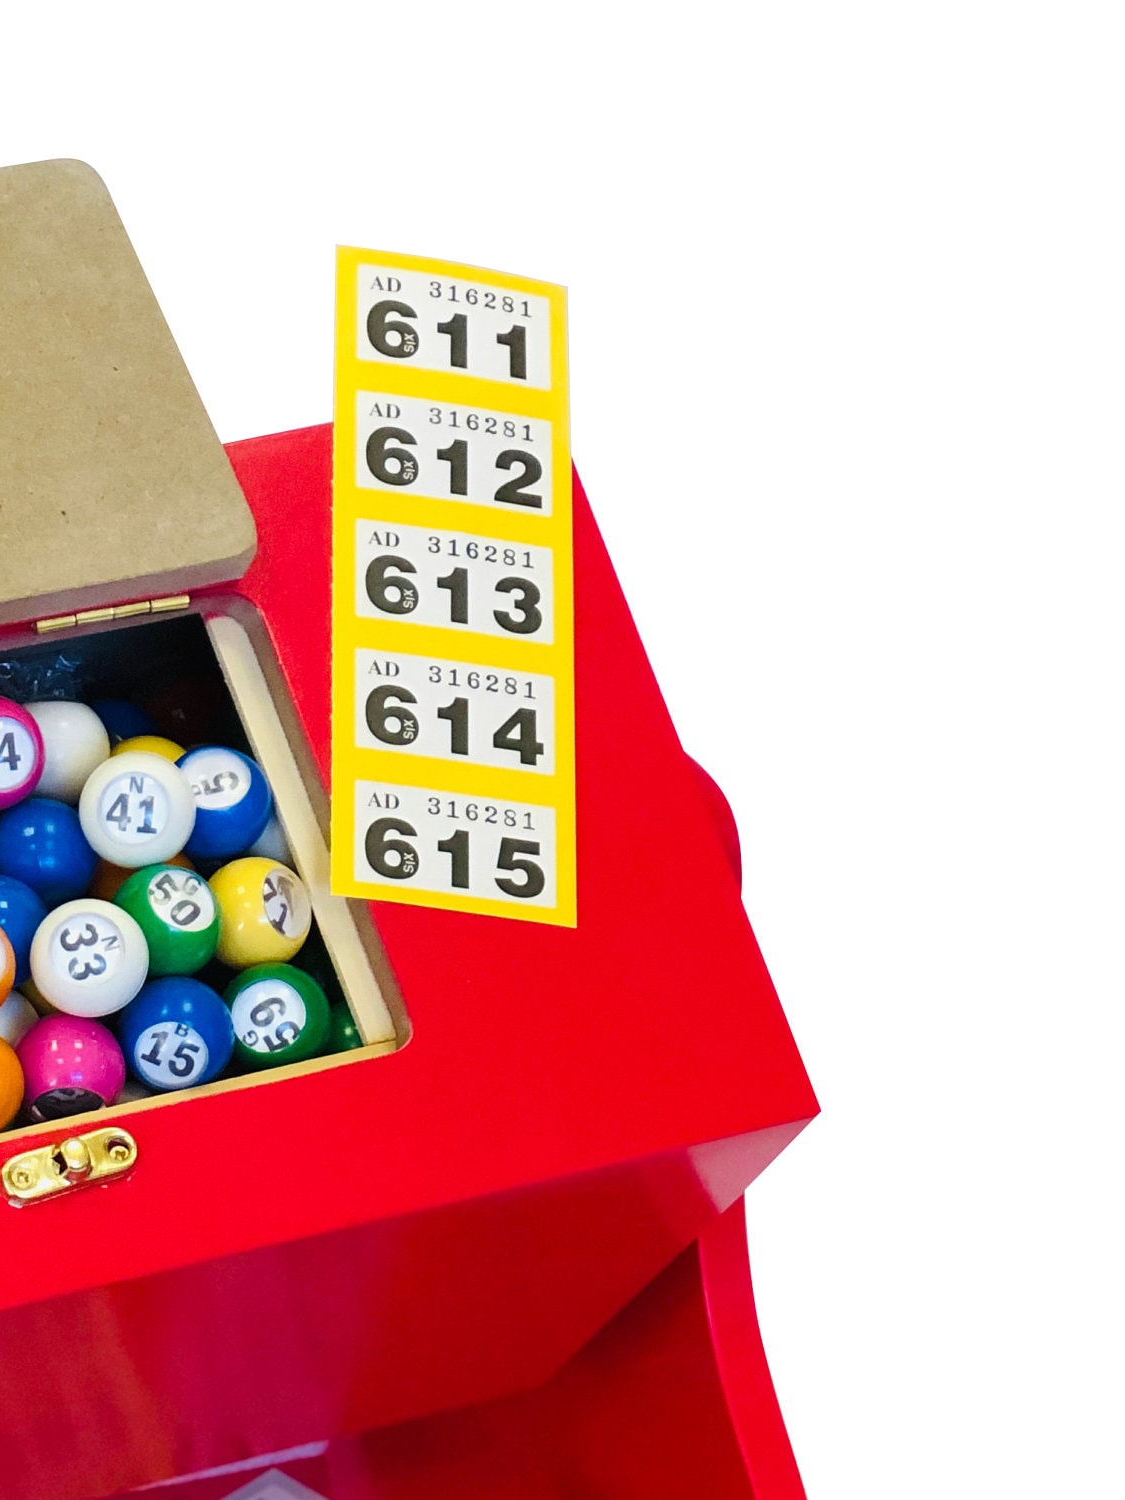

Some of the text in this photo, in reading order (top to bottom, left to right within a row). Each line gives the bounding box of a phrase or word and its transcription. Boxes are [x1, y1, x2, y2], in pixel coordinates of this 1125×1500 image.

[371, 277, 531, 317] AD 316281
[367, 300, 526, 380] 611
[429, 408, 533, 442] 316281
[366, 427, 542, 509] 612
[428, 537, 533, 568] 316281
[365, 555, 542, 634] 613
[368, 661, 535, 699] AD 316281
[365, 685, 544, 766] 614
[129, 776, 144, 794] N
[106, 793, 159, 835] 41
[428, 798, 534, 830] 316281
[365, 818, 545, 898] 615
[150, 874, 202, 927] 50
[59, 923, 106, 981] 33
[250, 997, 301, 1053] 59
[141, 1030, 196, 1077] 15
